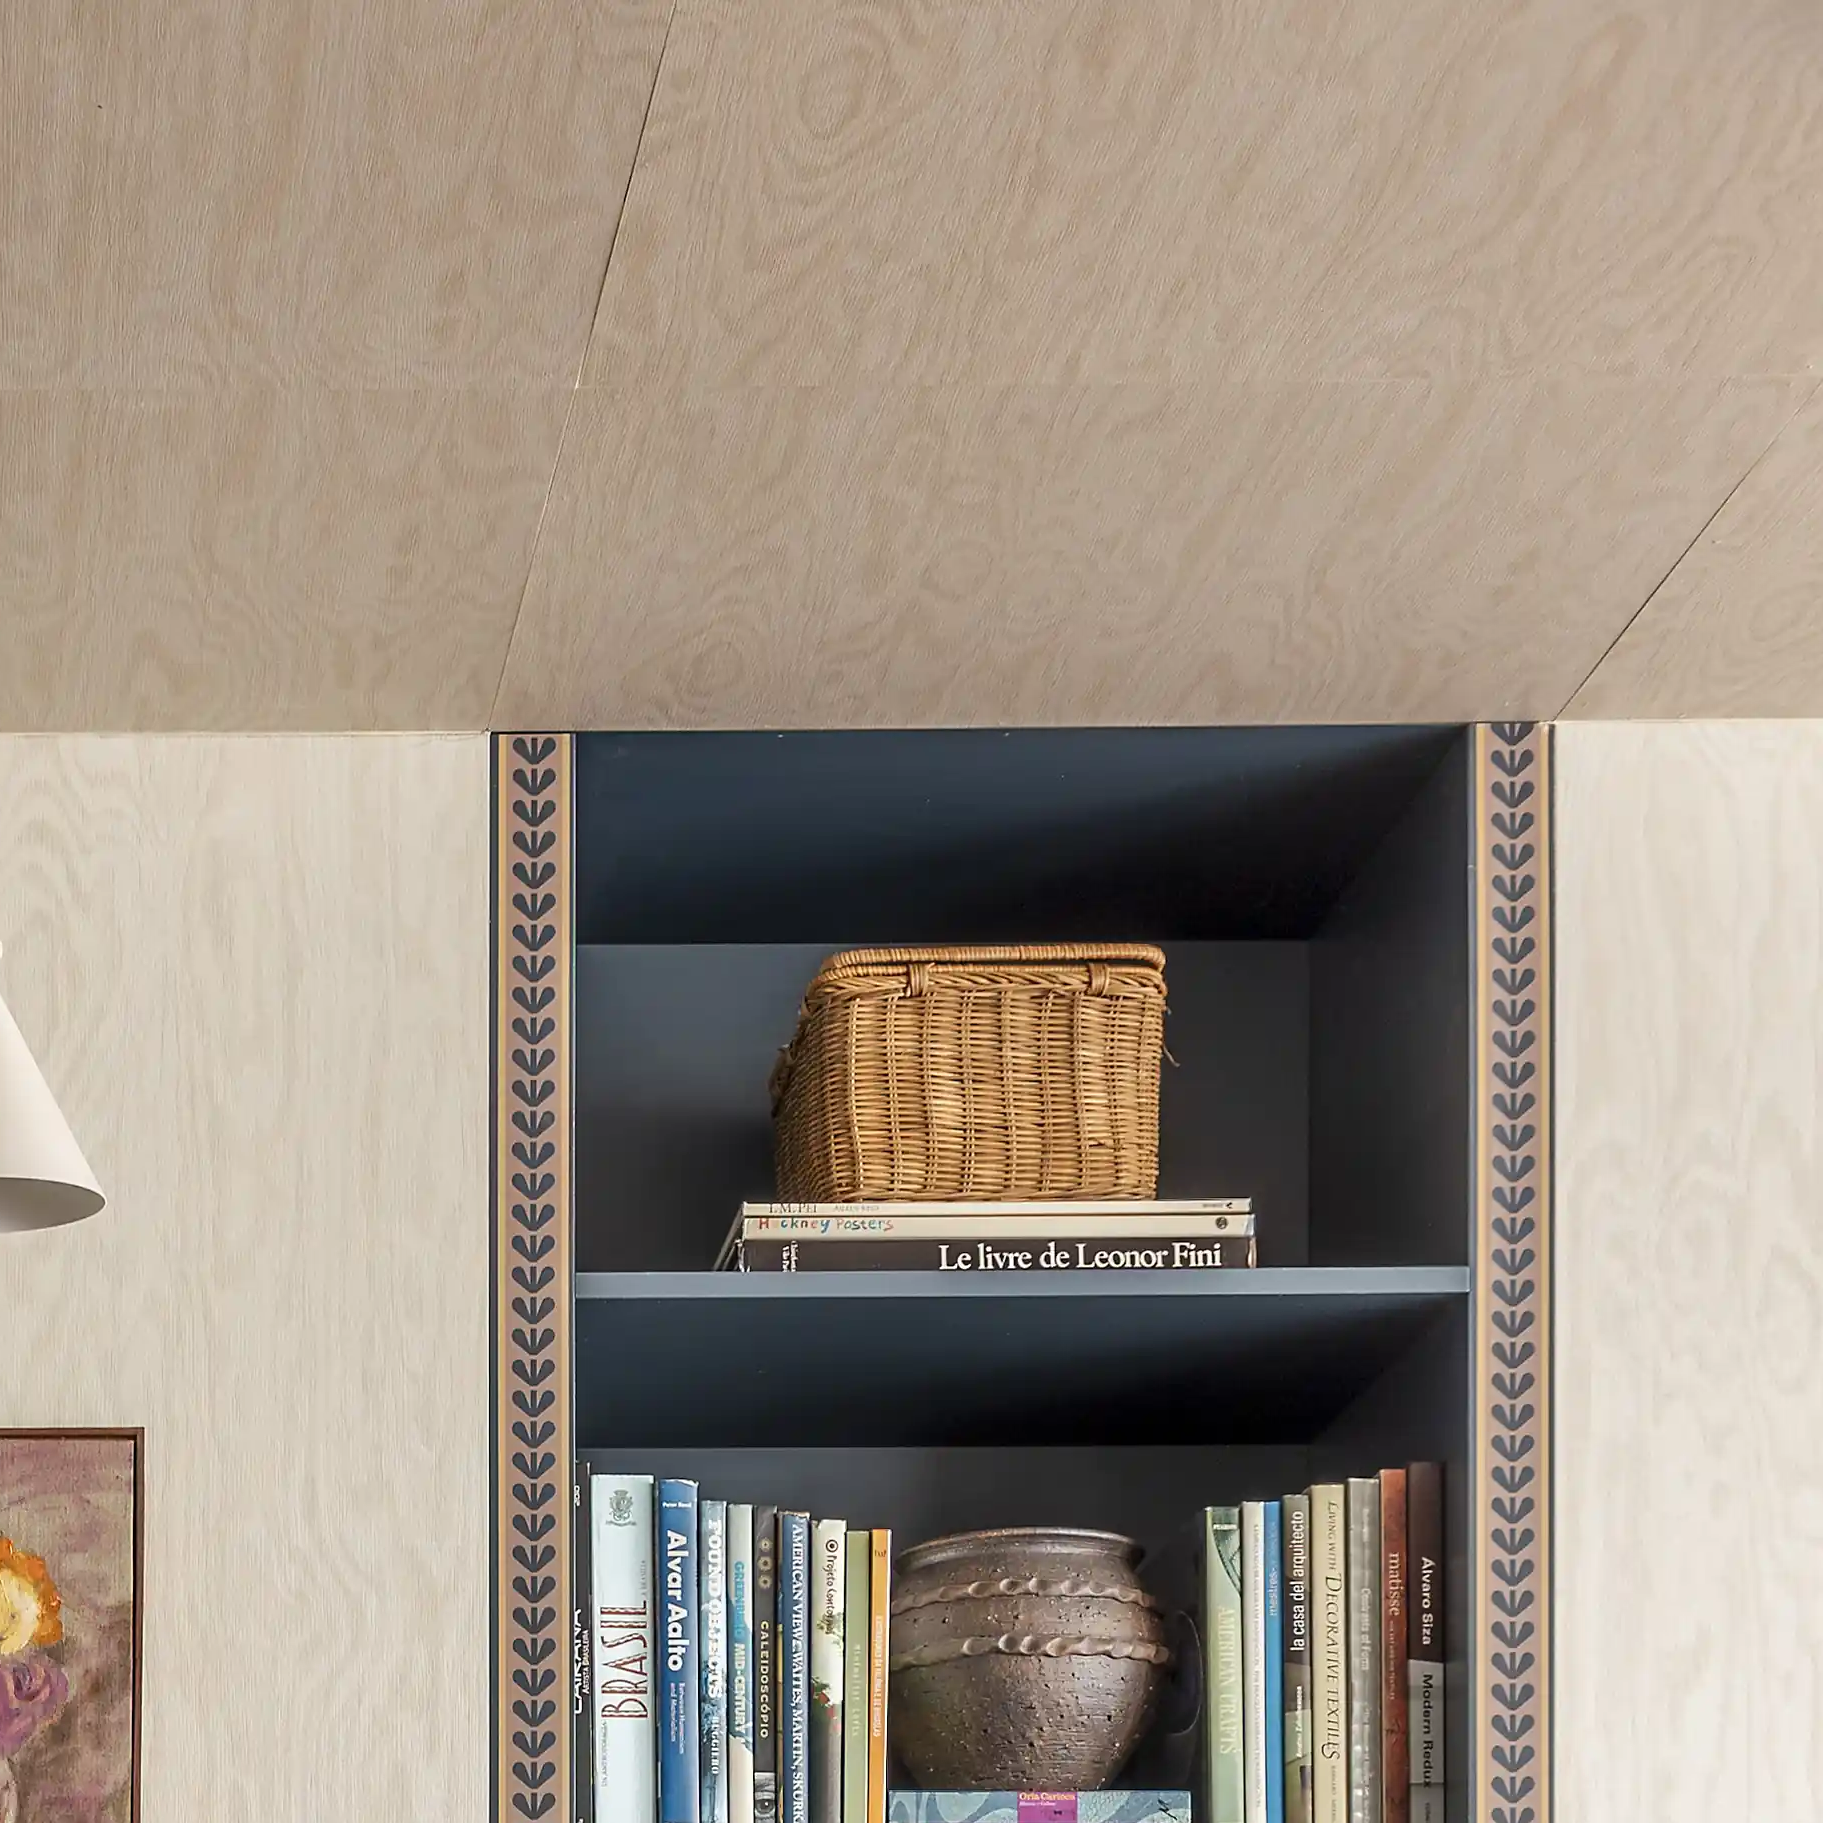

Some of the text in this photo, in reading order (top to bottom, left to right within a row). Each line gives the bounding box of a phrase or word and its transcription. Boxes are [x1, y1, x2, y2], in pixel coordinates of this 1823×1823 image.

[758, 1217, 894, 1233] Hckney Posters
[939, 1242, 1221, 1270] Le livre de Leonor Fini
[666, 1530, 688, 1671] Alvar Aalto
[1290, 1511, 1305, 1651] la casa del arquitecto
[1389, 1553, 1401, 1616] matisse
[1421, 1557, 1435, 1645] Álvaro Siza
[601, 1601, 648, 1718] BRASIL
[760, 1621, 771, 1738] CALEIDOSCÓPIO
[1423, 1674, 1434, 1788] Modern Redux
